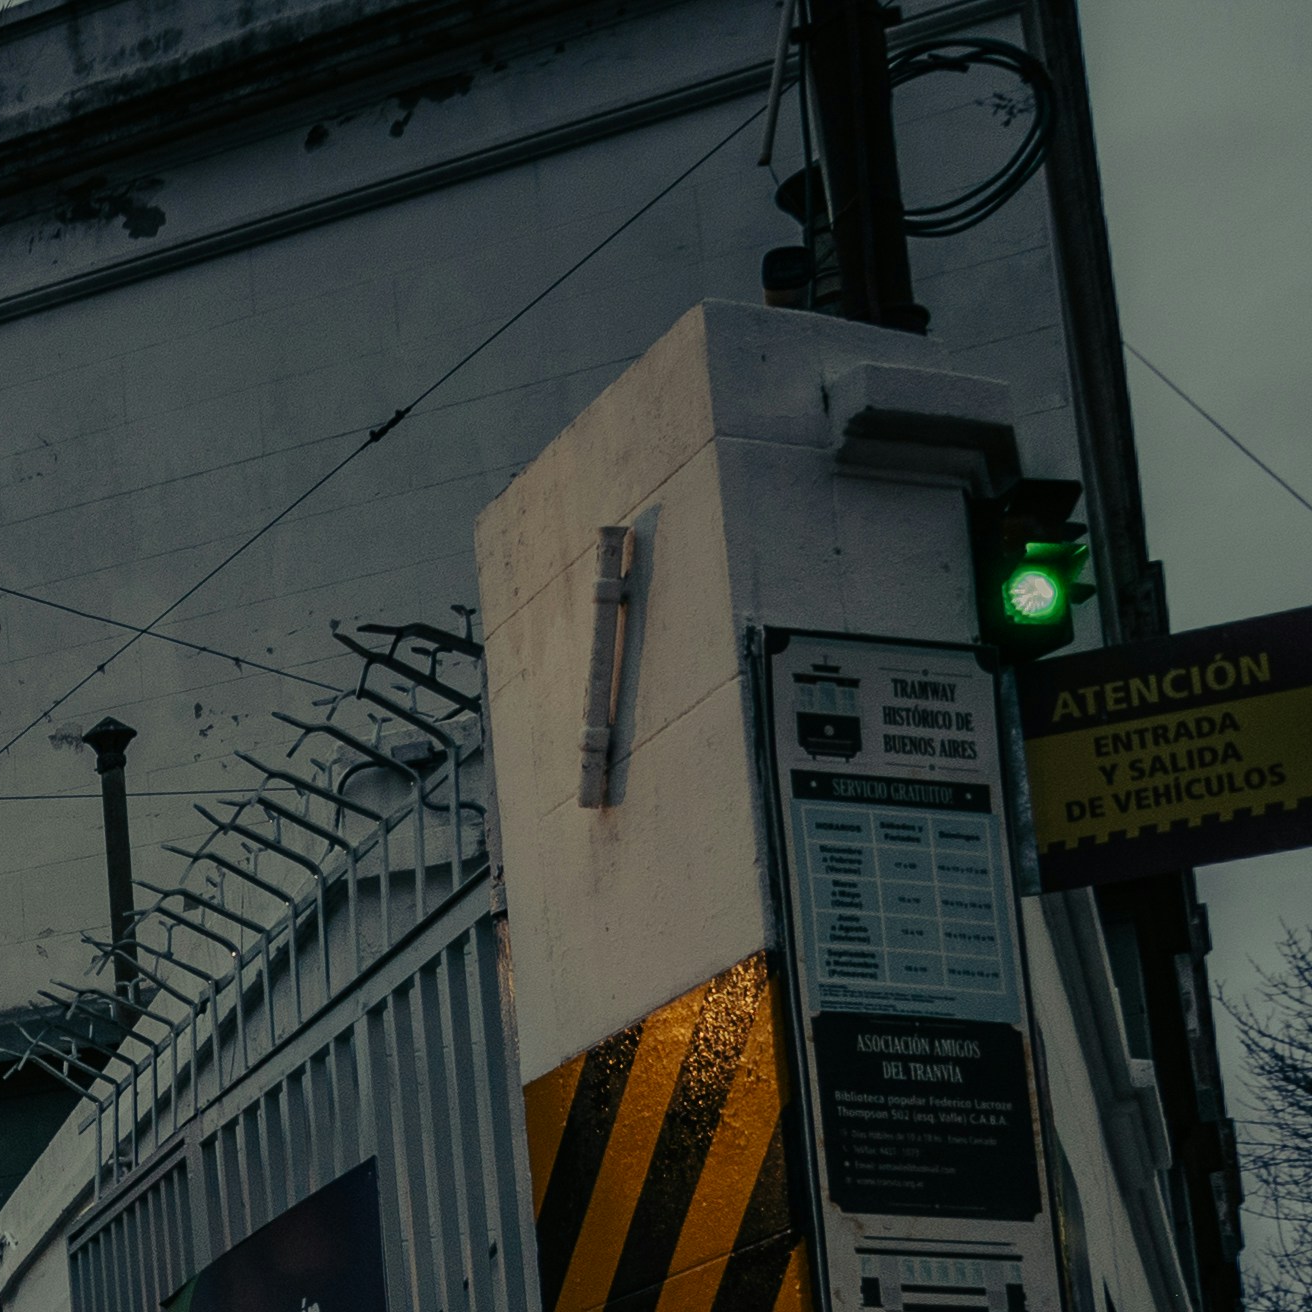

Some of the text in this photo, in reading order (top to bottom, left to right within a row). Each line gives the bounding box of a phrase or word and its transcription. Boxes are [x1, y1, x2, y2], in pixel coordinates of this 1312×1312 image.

[891, 678, 957, 702] TRAMWAY
[1051, 652, 1272, 723] ATENCIÓN
[882, 705, 974, 732] HISTÓRICO DE
[883, 734, 977, 759] BUENOS AIRES
[1093, 711, 1241, 758] ENTRADA
[1099, 741, 1244, 786] Y SALIDA
[831, 778, 955, 804] SERVICIO GRATUITO!
[1065, 763, 1287, 823] DE VEHÍCULOS
[856, 1032, 981, 1059] ASOCIACIÓN AMIGOS
[882, 1061, 964, 1083] DEL TRANVÍA
[834, 1090, 1012, 1111] Biblioteca popular Federico Lacroze
[837, 1106, 888, 1121] Thompson
[938, 1112, 967, 1126] Valle)
